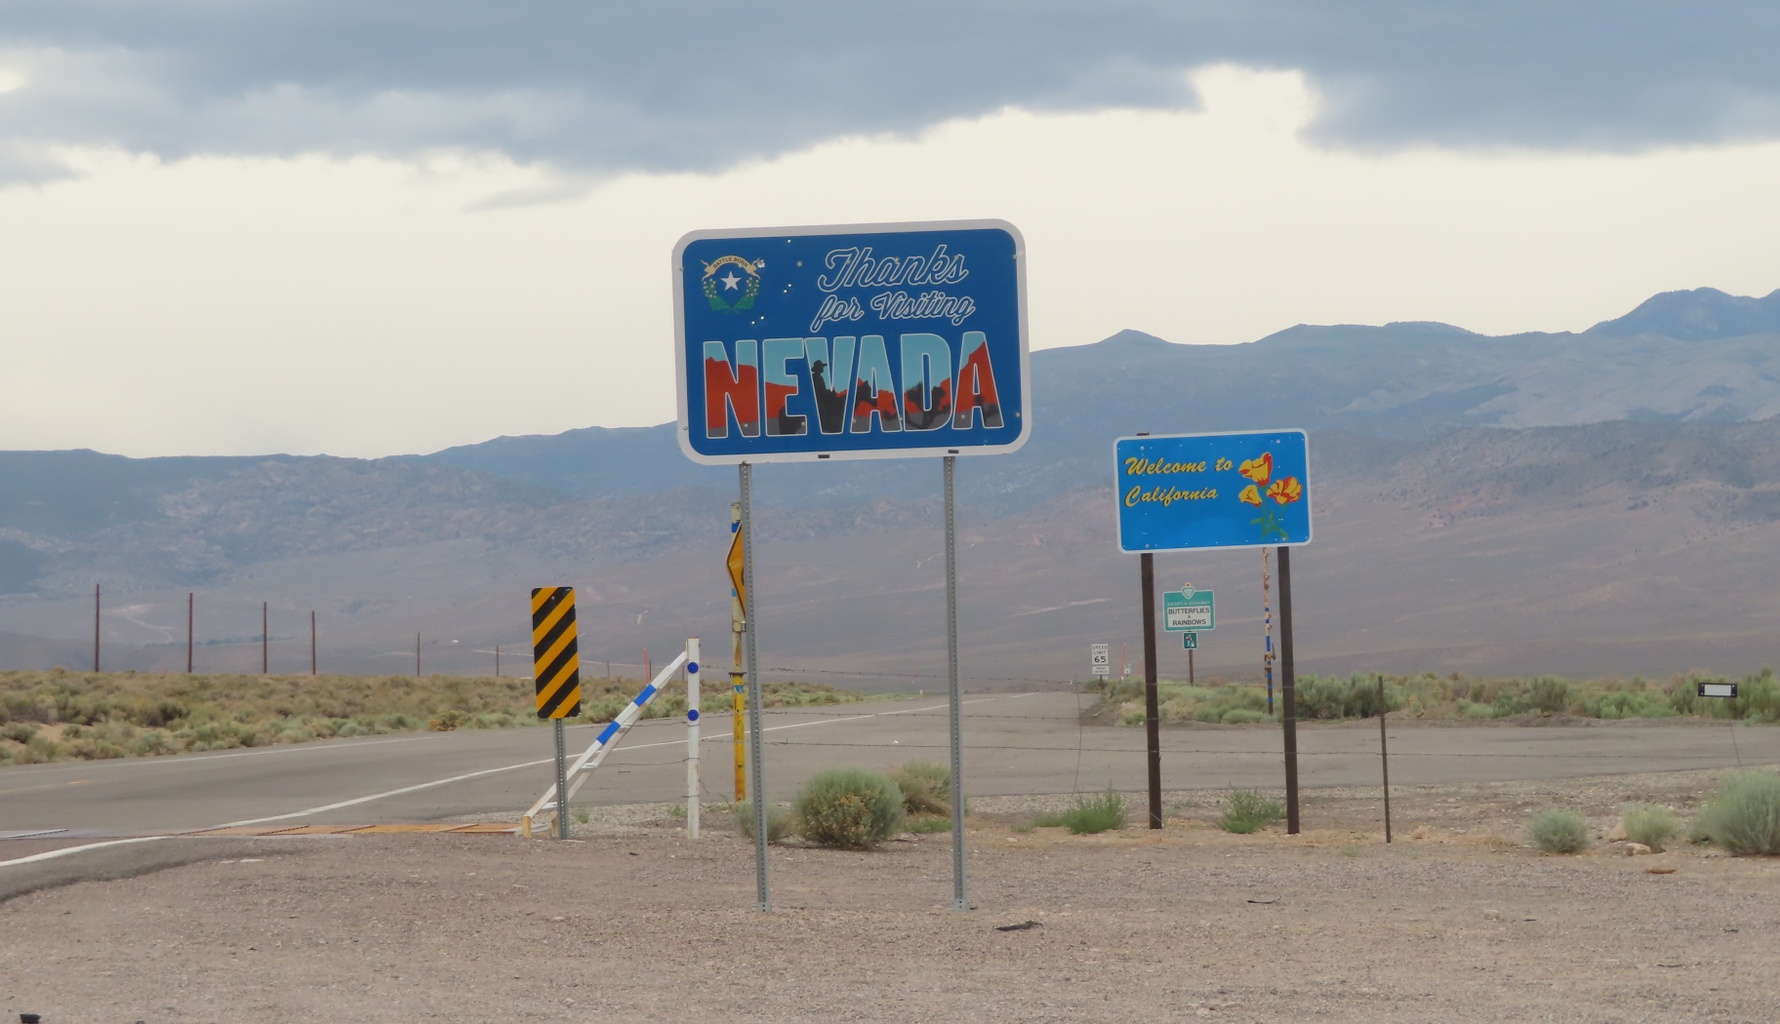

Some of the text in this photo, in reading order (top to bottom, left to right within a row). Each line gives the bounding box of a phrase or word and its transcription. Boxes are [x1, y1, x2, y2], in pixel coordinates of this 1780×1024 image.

[713, 257, 748, 269] BATTLE BORN
[818, 244, 969, 292] Thanks
[810, 291, 976, 333] for Visiting
[703, 331, 1005, 439] NEVADA
[1124, 456, 1234, 475] Welcome to
[1124, 485, 1218, 507] California
[1168, 607, 1210, 615] BUTTERFLIES
[1095, 655, 1107, 663] 65
